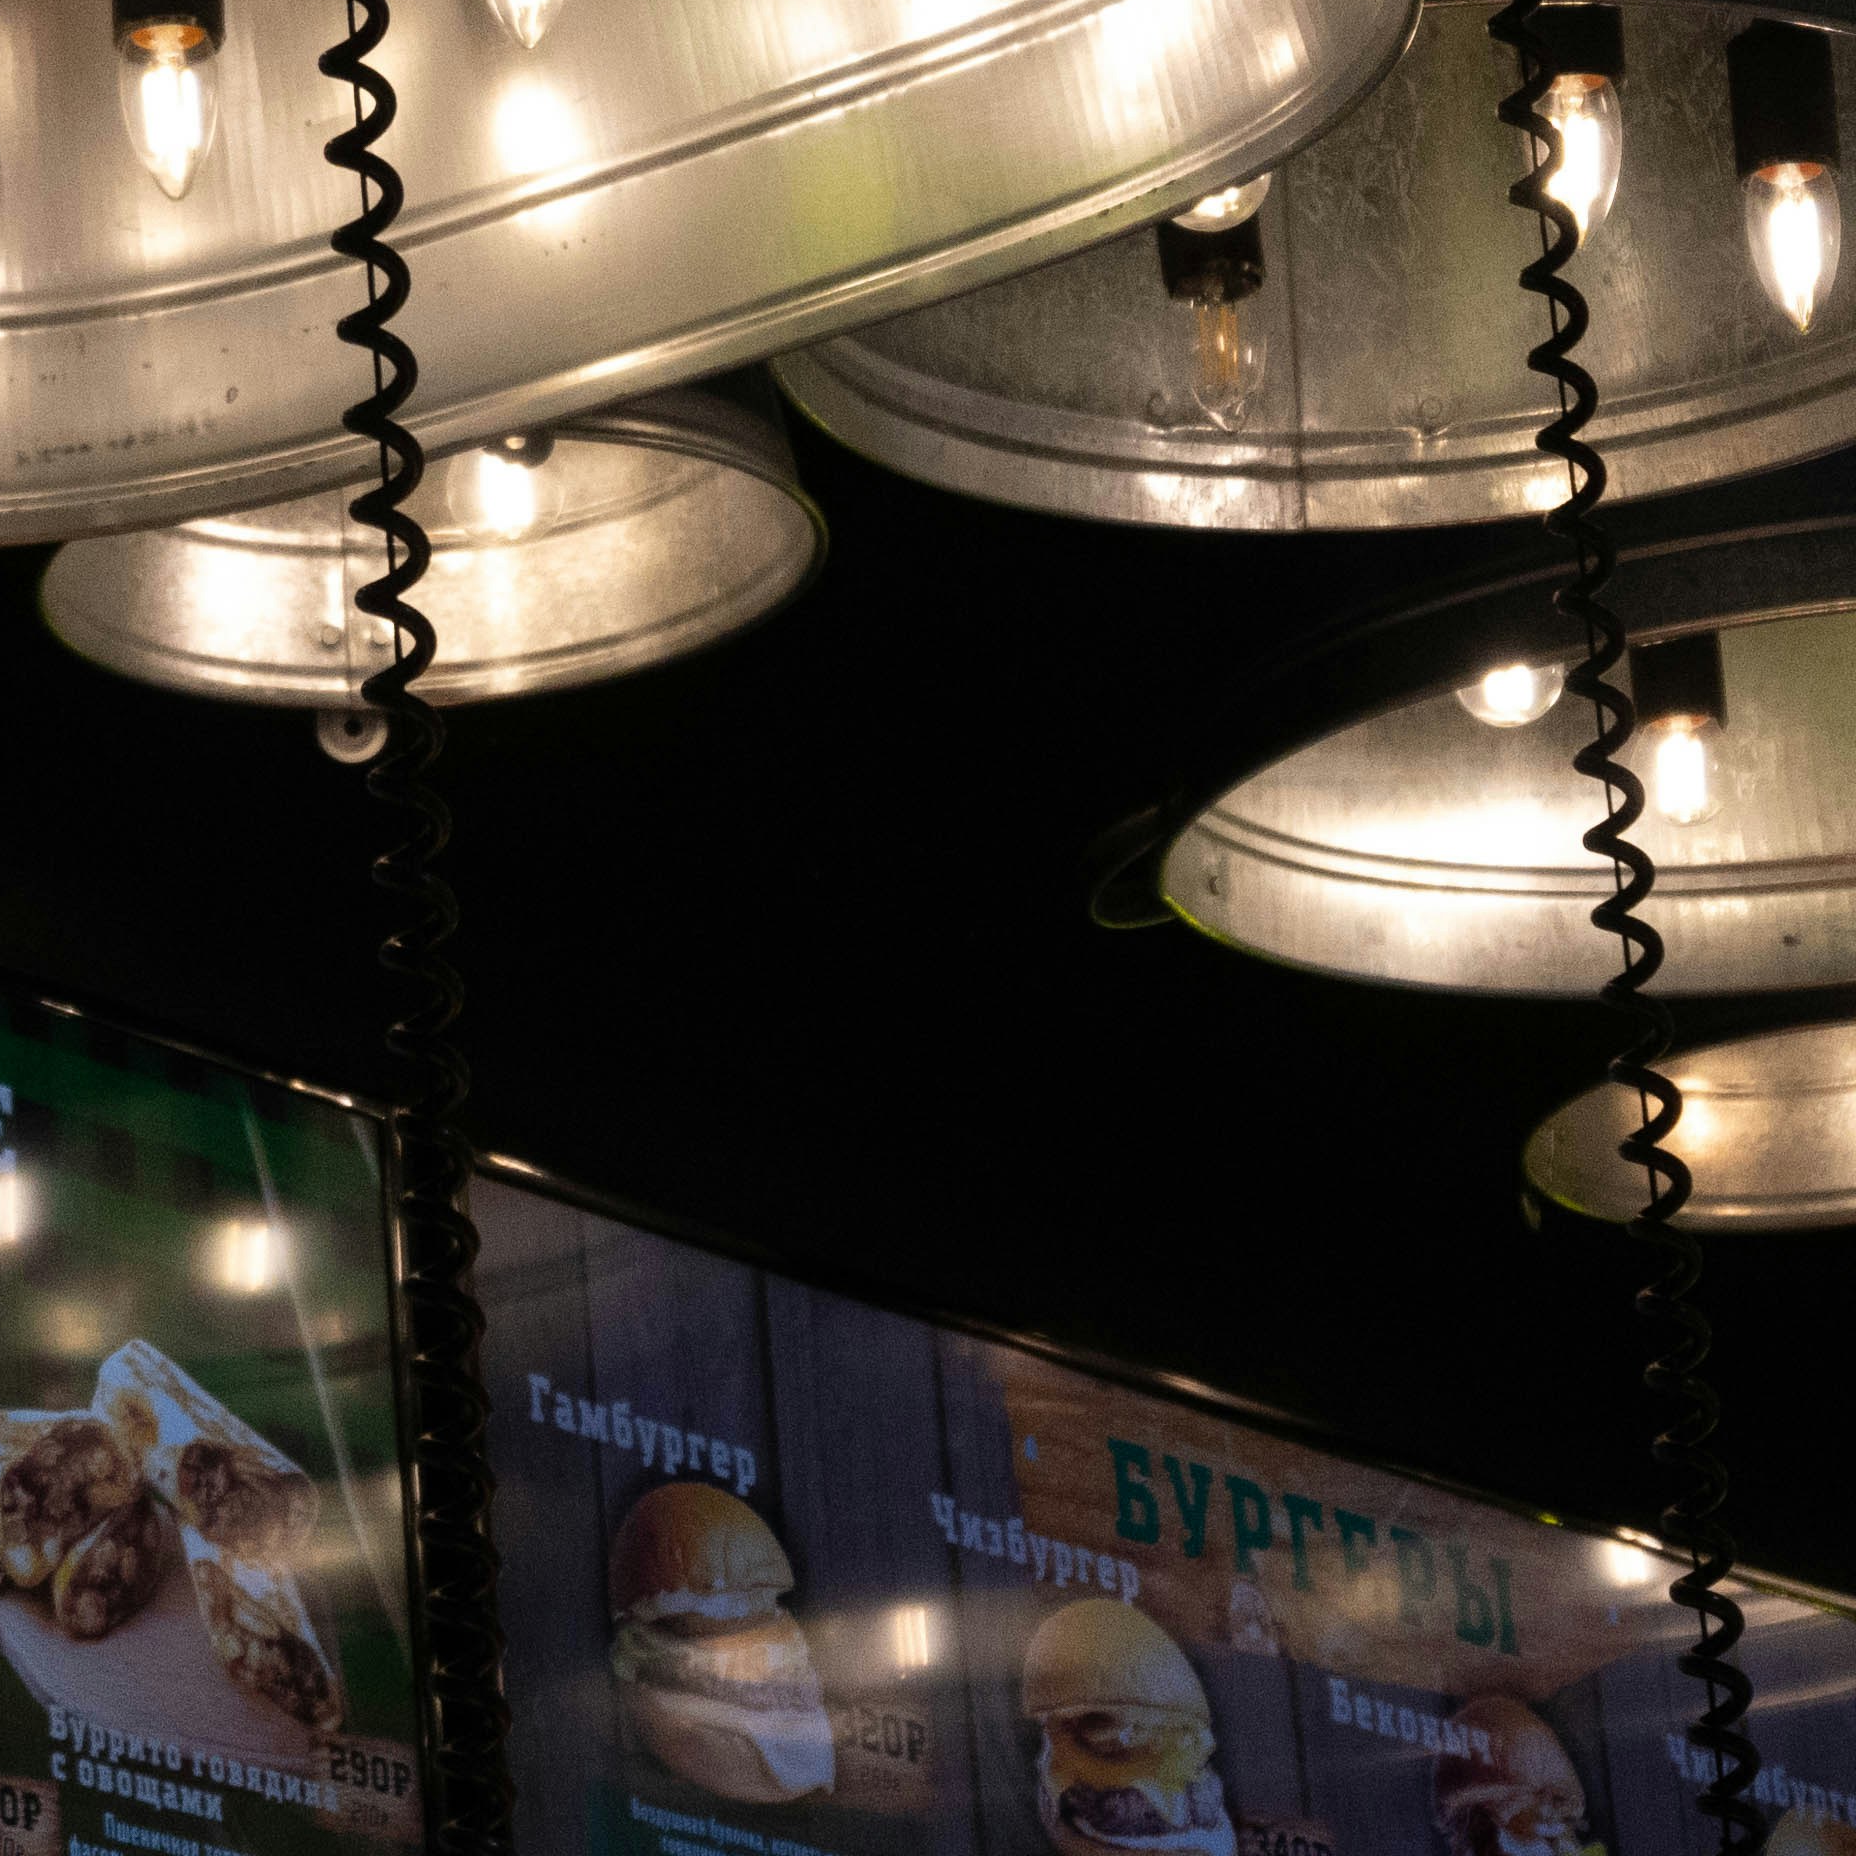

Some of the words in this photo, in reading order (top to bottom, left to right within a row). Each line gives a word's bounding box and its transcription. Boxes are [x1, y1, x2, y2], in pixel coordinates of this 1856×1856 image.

[529, 1373, 758, 1497] Гамбургер
[931, 1492, 1141, 1606] Чизбургер
[48, 1703, 182, 1773] Буррито
[193, 1745, 341, 1814] говядина
[50, 1750, 68, 1782] с
[77, 1759, 224, 1823] овощами
